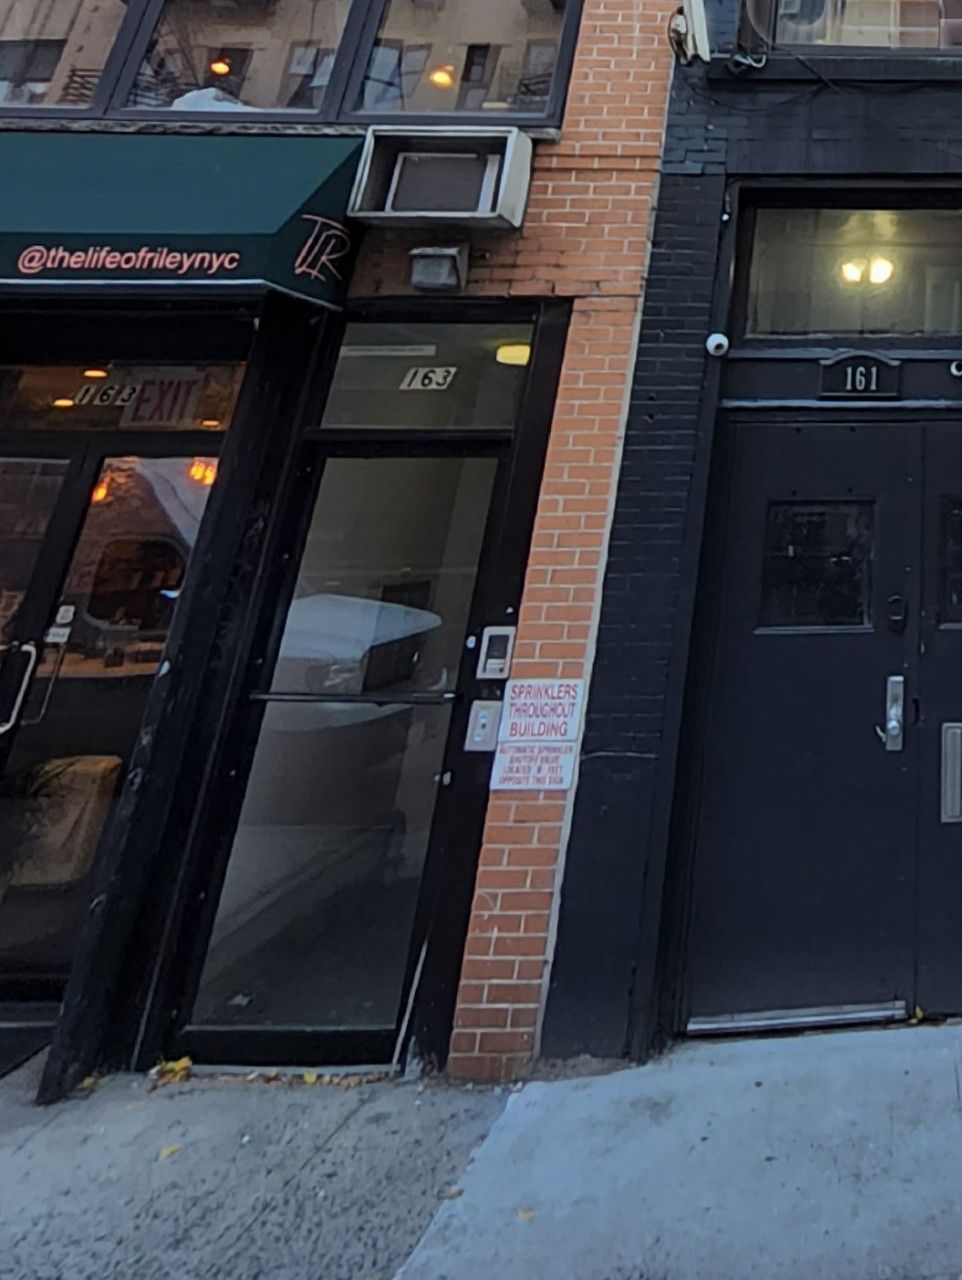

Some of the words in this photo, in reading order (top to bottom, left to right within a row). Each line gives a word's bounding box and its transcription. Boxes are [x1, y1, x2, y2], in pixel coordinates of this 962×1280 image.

[17, 245, 240, 274] @thelifeofrileynyc
[407, 368, 452, 388] 163
[845, 365, 878, 391] 161
[77, 383, 136, 405] 163
[132, 378, 199, 422] EXIT
[510, 683, 578, 701] SPRINKLERS
[509, 702, 577, 719] THROUGHOUT
[509, 721, 568, 737] BUILDING
